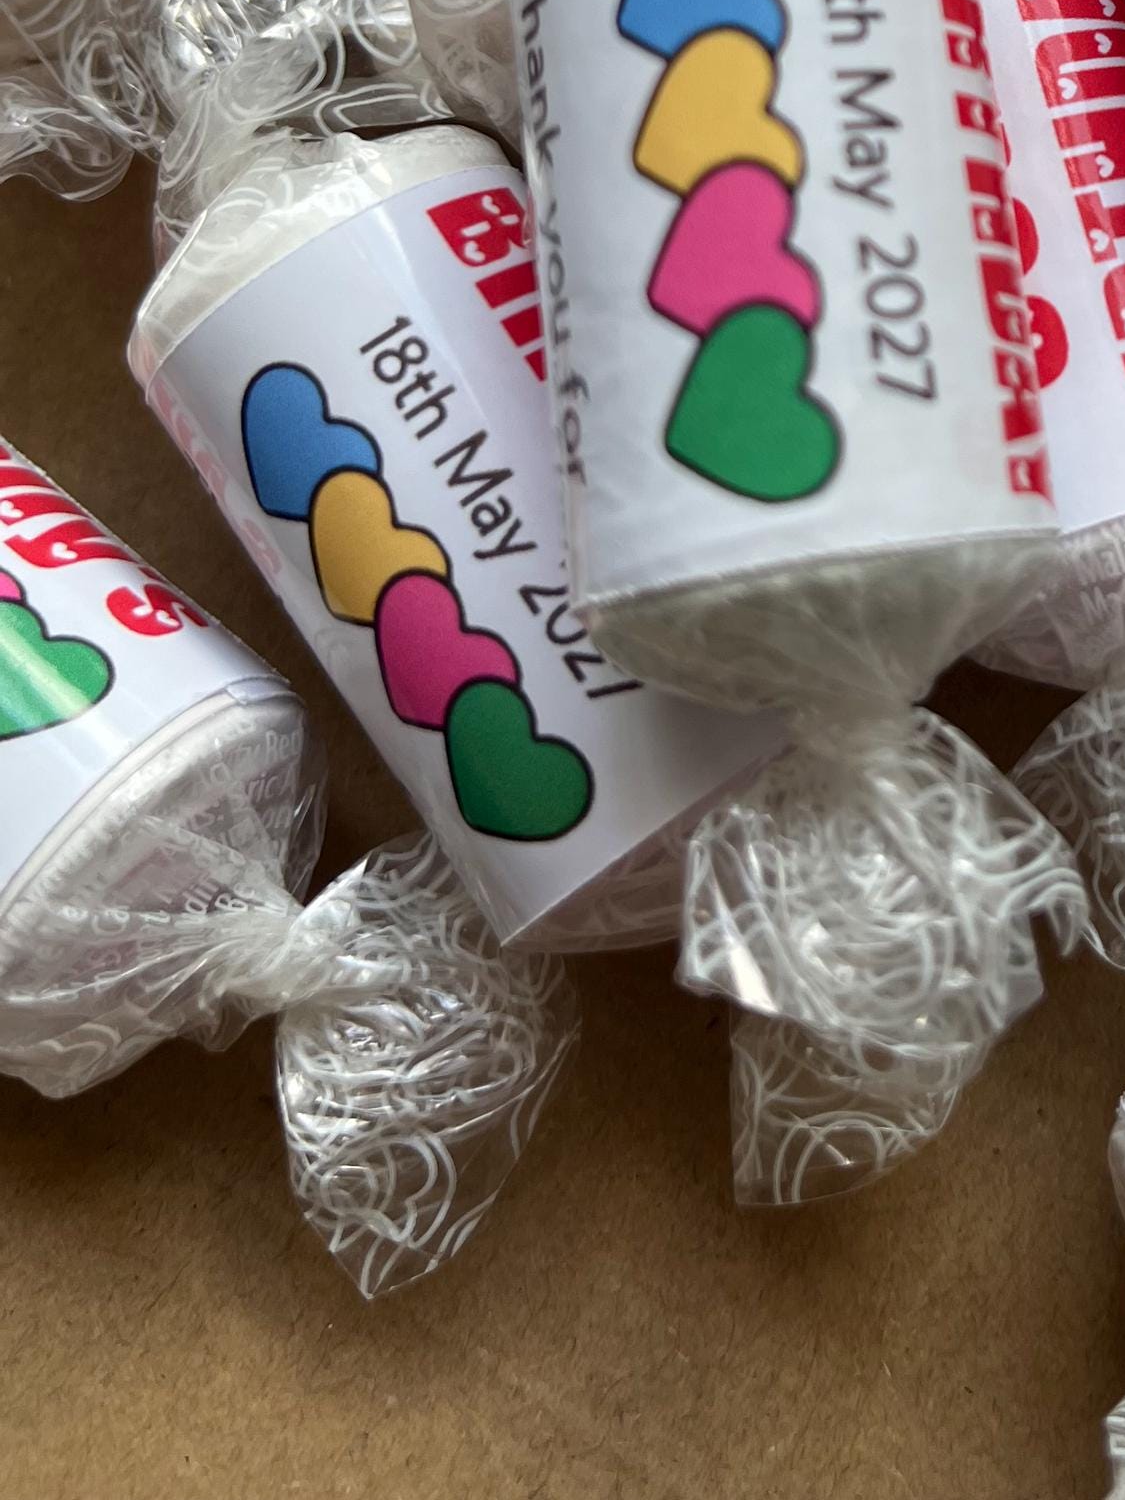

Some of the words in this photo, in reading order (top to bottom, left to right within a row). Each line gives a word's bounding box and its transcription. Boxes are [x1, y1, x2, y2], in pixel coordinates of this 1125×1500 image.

[830, 66, 903, 210] May
[855, 232, 938, 403] 2027
[359, 315, 457, 441] 18th
[433, 429, 538, 560] May
